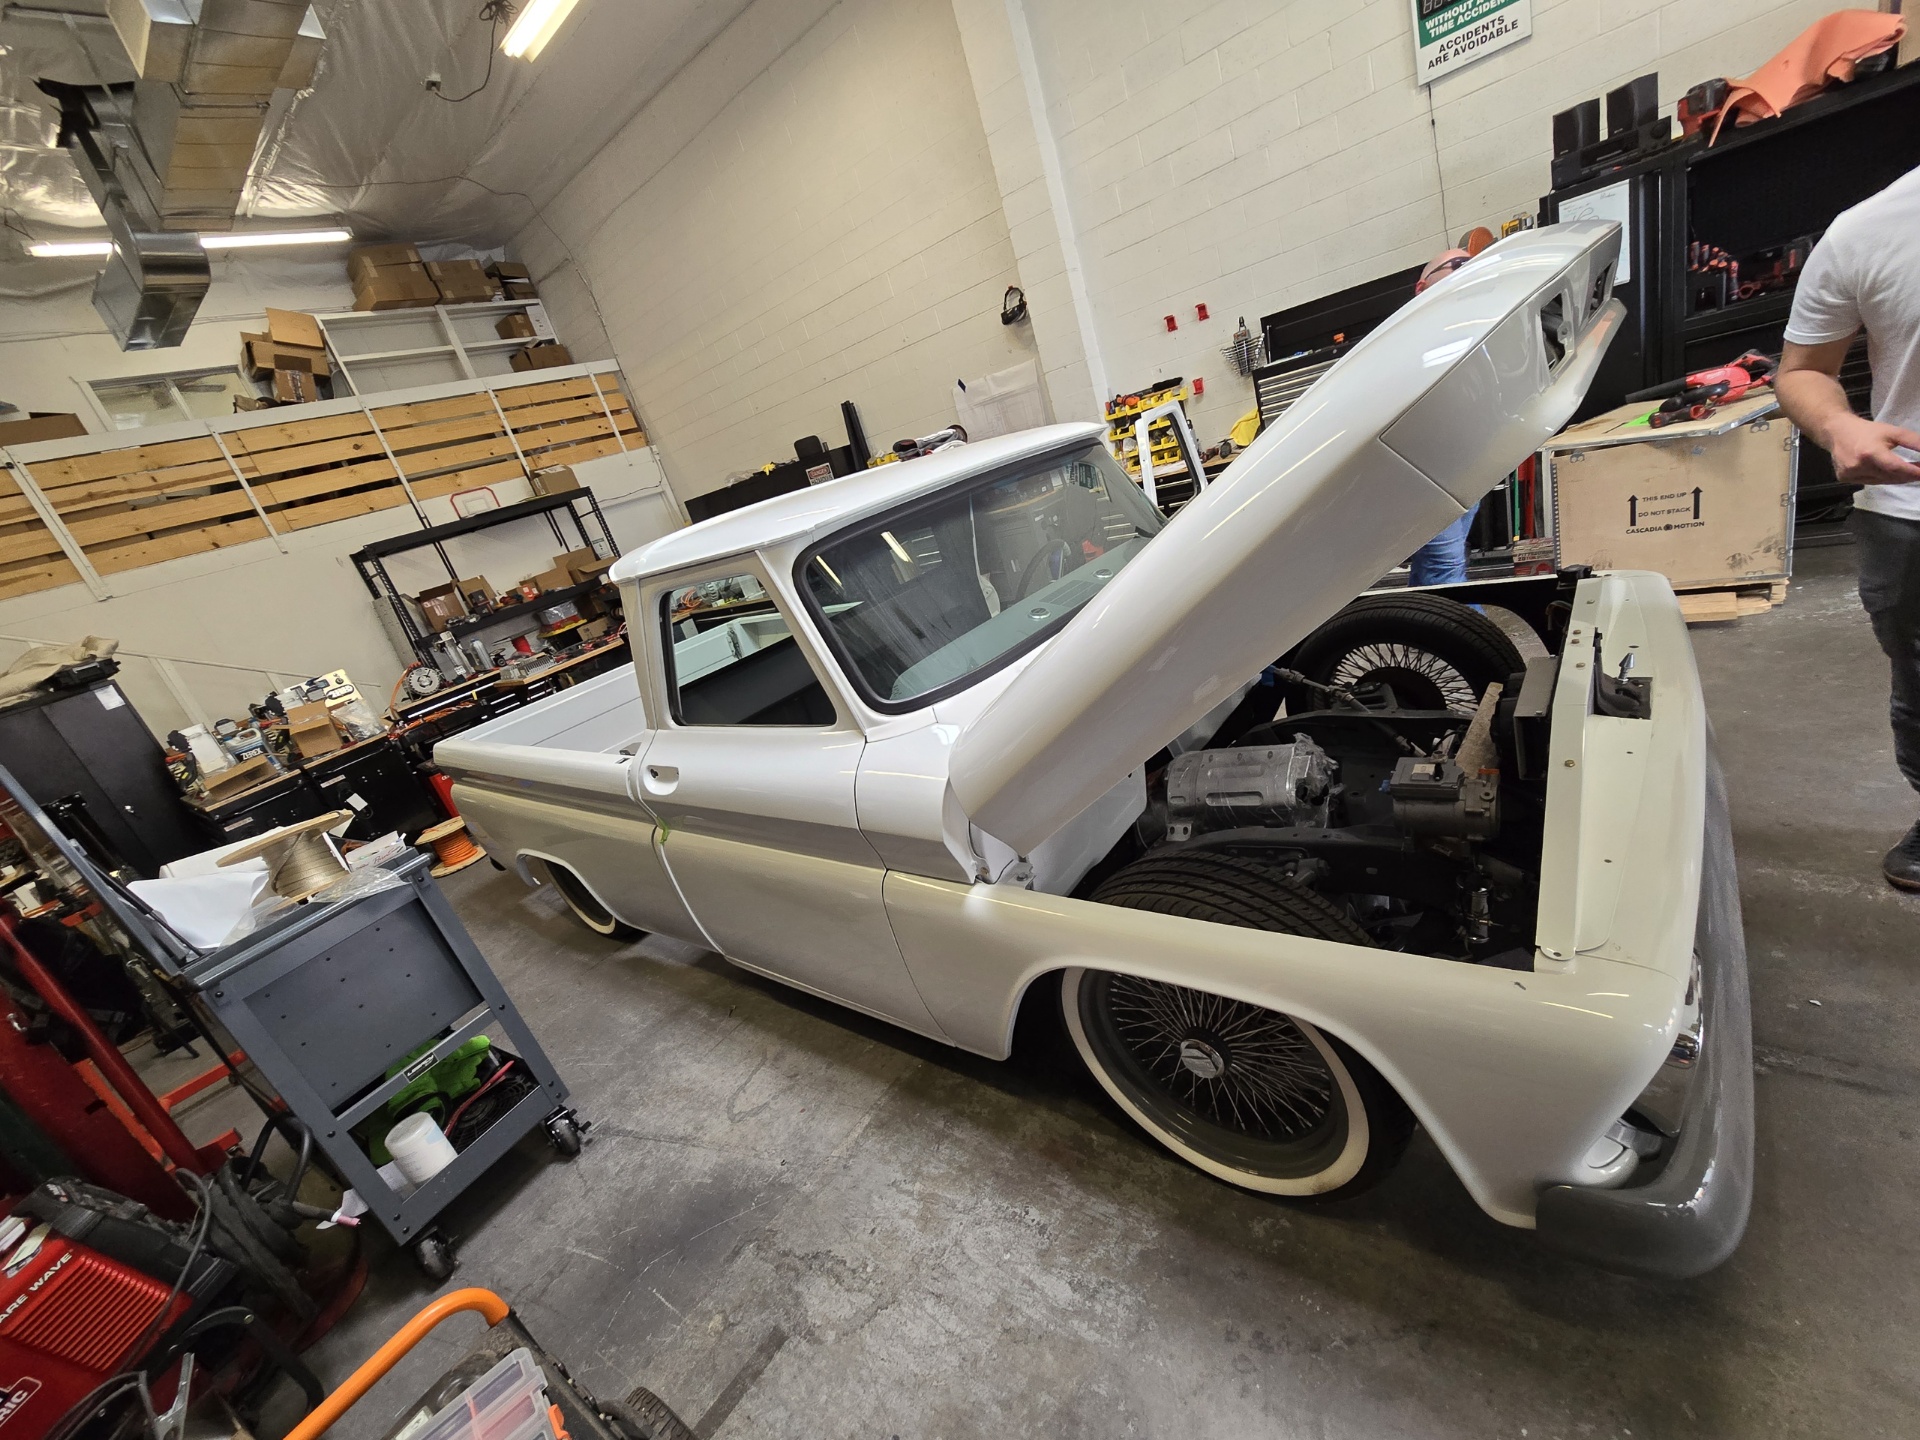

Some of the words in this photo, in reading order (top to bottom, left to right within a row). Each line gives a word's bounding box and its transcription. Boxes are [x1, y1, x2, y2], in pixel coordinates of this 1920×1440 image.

[1425, 0, 1474, 30] WITHOUT
[1429, 19, 1455, 38] TIME
[1439, 15, 1505, 54] ACCIDENTS
[1428, 53, 1453, 70] ARE
[1453, 19, 1519, 58] AVOIDABLE
[1666, 506, 1691, 515] STACK
[1626, 525, 1663, 534] CASCADIA
[1673, 521, 1705, 530] MOTION
[240, 747, 263, 760] ZEREX
[29, 1252, 72, 1291] WAVE
